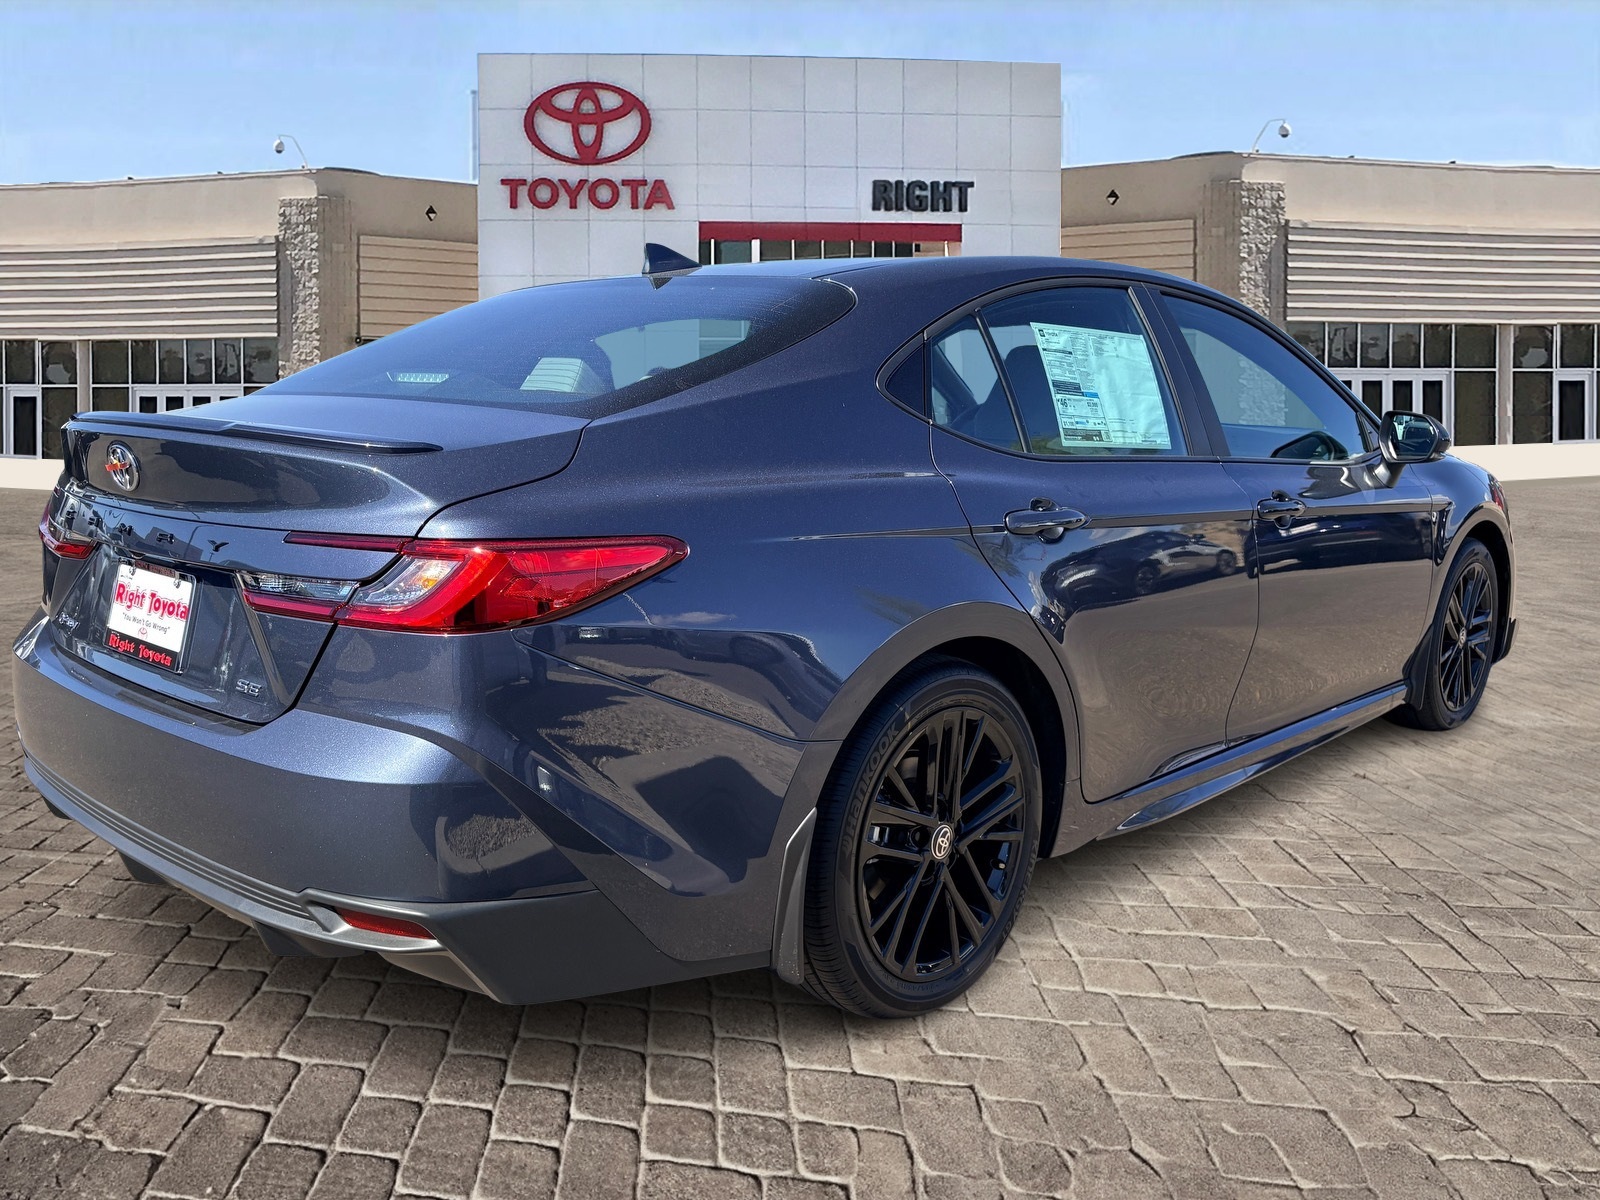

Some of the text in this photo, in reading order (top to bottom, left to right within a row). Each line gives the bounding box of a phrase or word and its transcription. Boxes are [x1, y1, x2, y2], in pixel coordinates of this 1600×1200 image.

[500, 179, 675, 210] TOYOTA
[871, 179, 975, 213] RIGHT
[115, 582, 190, 621] Right Toyota
[122, 612, 171, 635] "You Won't Go Wrong"
[109, 633, 173, 667] Right Toyota
[235, 678, 262, 698] SE
